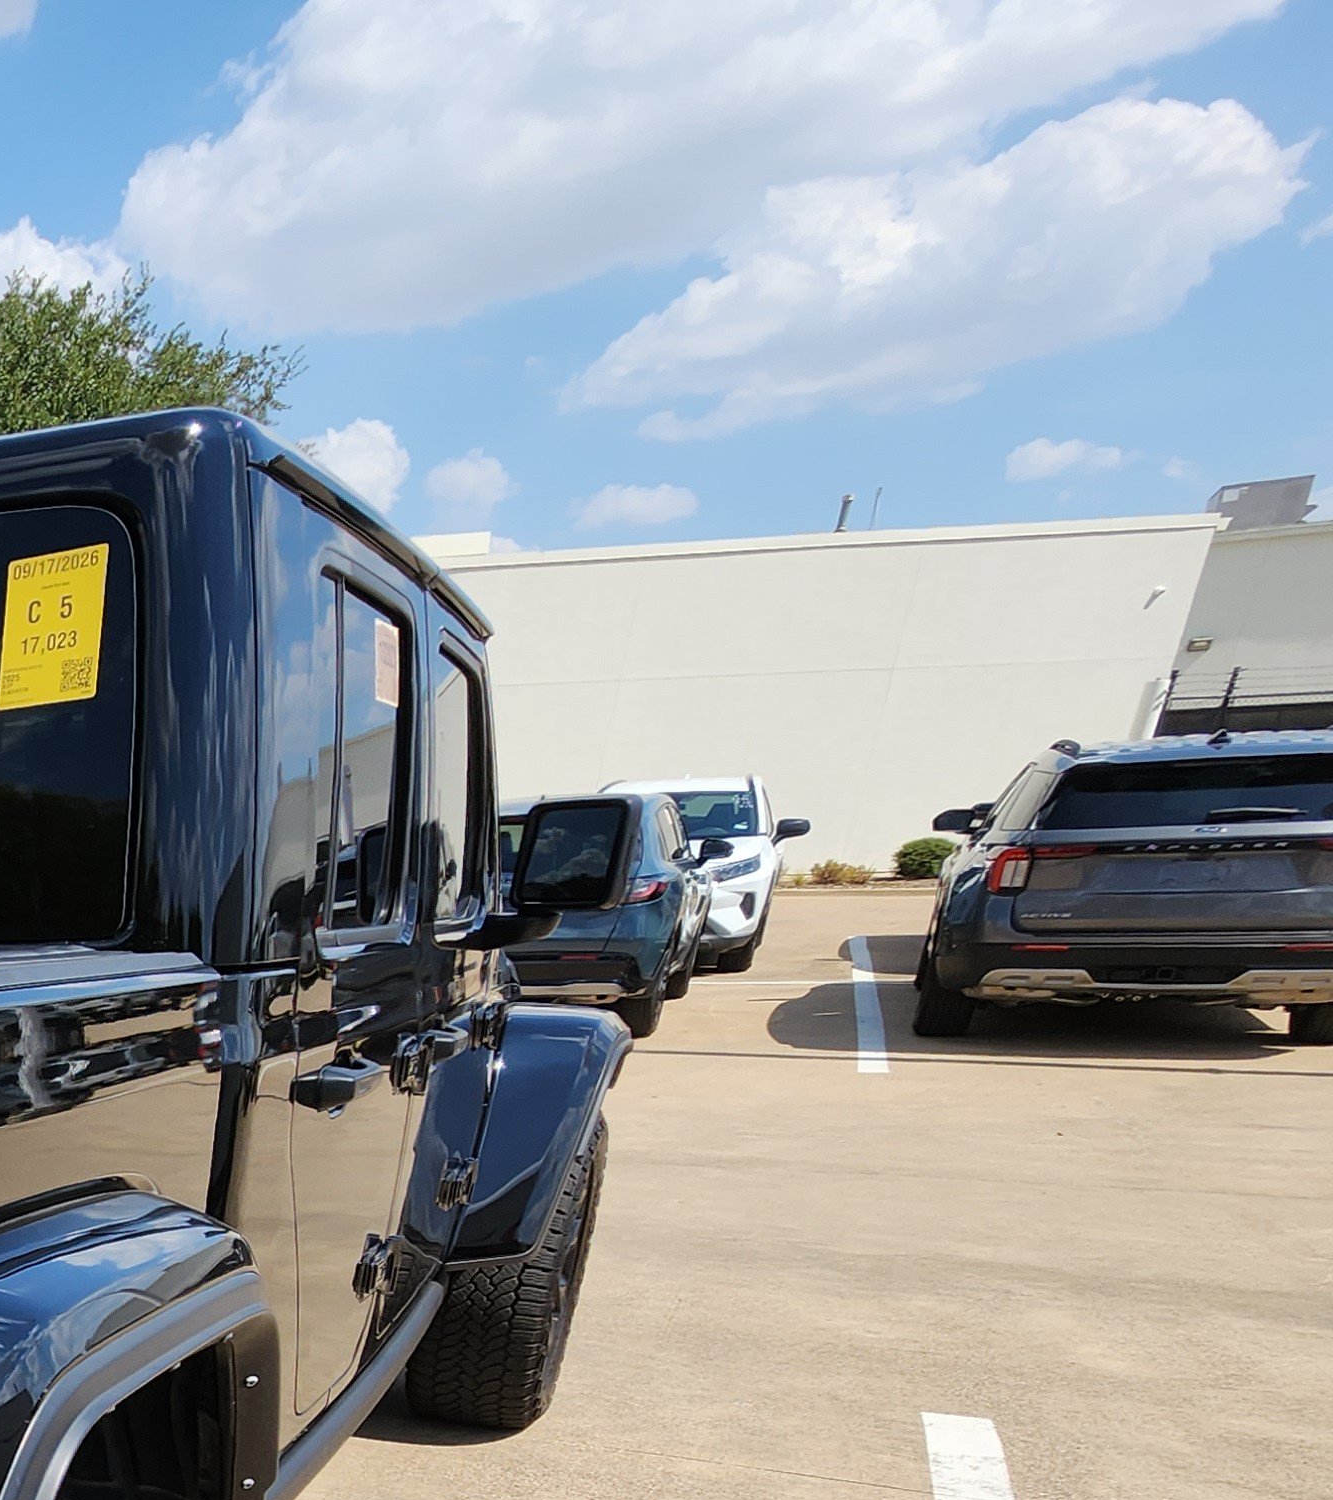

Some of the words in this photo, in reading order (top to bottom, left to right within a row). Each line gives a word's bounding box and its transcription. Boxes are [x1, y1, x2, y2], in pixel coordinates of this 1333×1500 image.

[12, 549, 100, 581] 09/17/2026
[27, 600, 41, 624] C
[59, 594, 73, 619] 5
[21, 630, 78, 655] 17,023
[1123, 841, 1289, 852] EXPLORER
